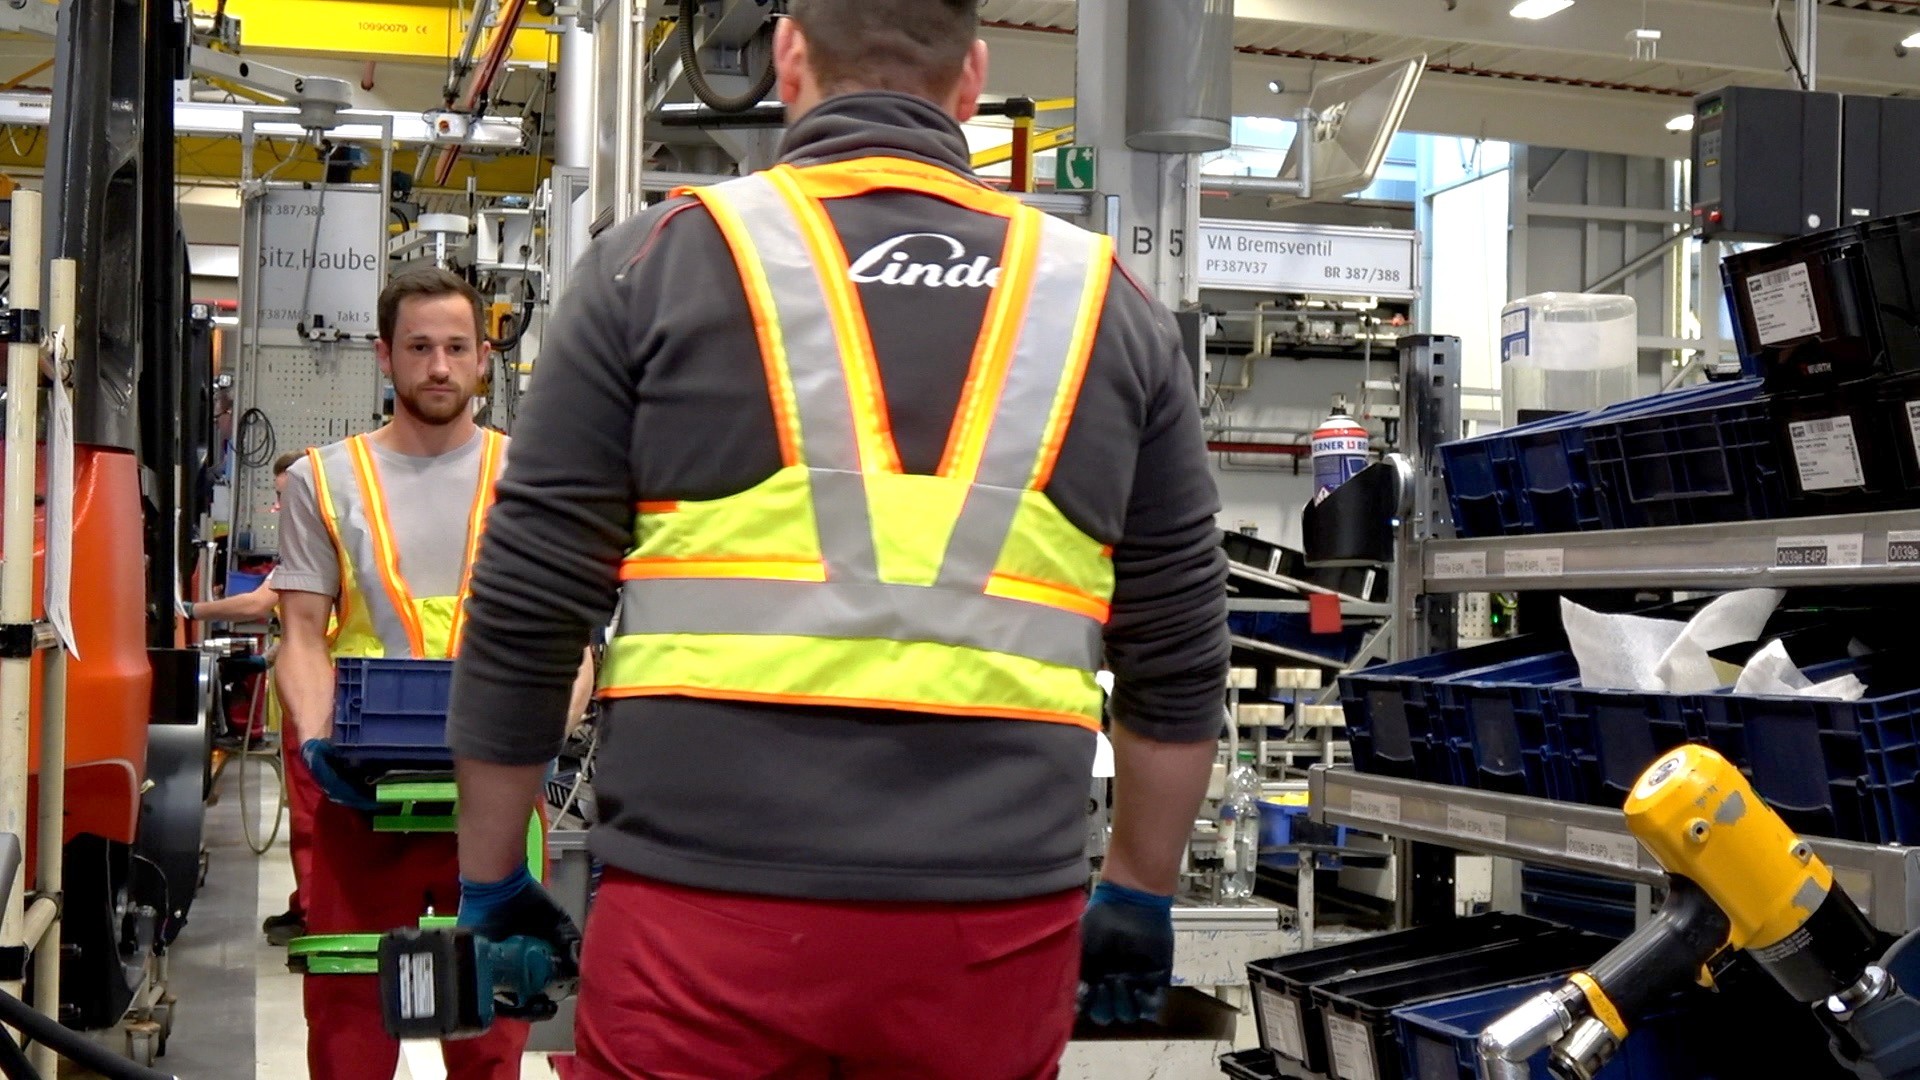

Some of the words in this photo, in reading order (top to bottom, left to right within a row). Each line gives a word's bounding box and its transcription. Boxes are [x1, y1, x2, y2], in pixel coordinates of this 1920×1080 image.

[359, 22, 408, 33] 10990079
[1133, 226, 1152, 255] B
[1169, 229, 1183, 257] 5
[1207, 234, 1231, 251] VM
[1237, 236, 1332, 257] Bremsventil
[1206, 259, 1268, 274] PF387V37
[1324, 266, 1341, 279] BR
[1345, 267, 1400, 284] 387/388
[337, 311, 359, 322] Takt
[364, 312, 370, 323] 5
